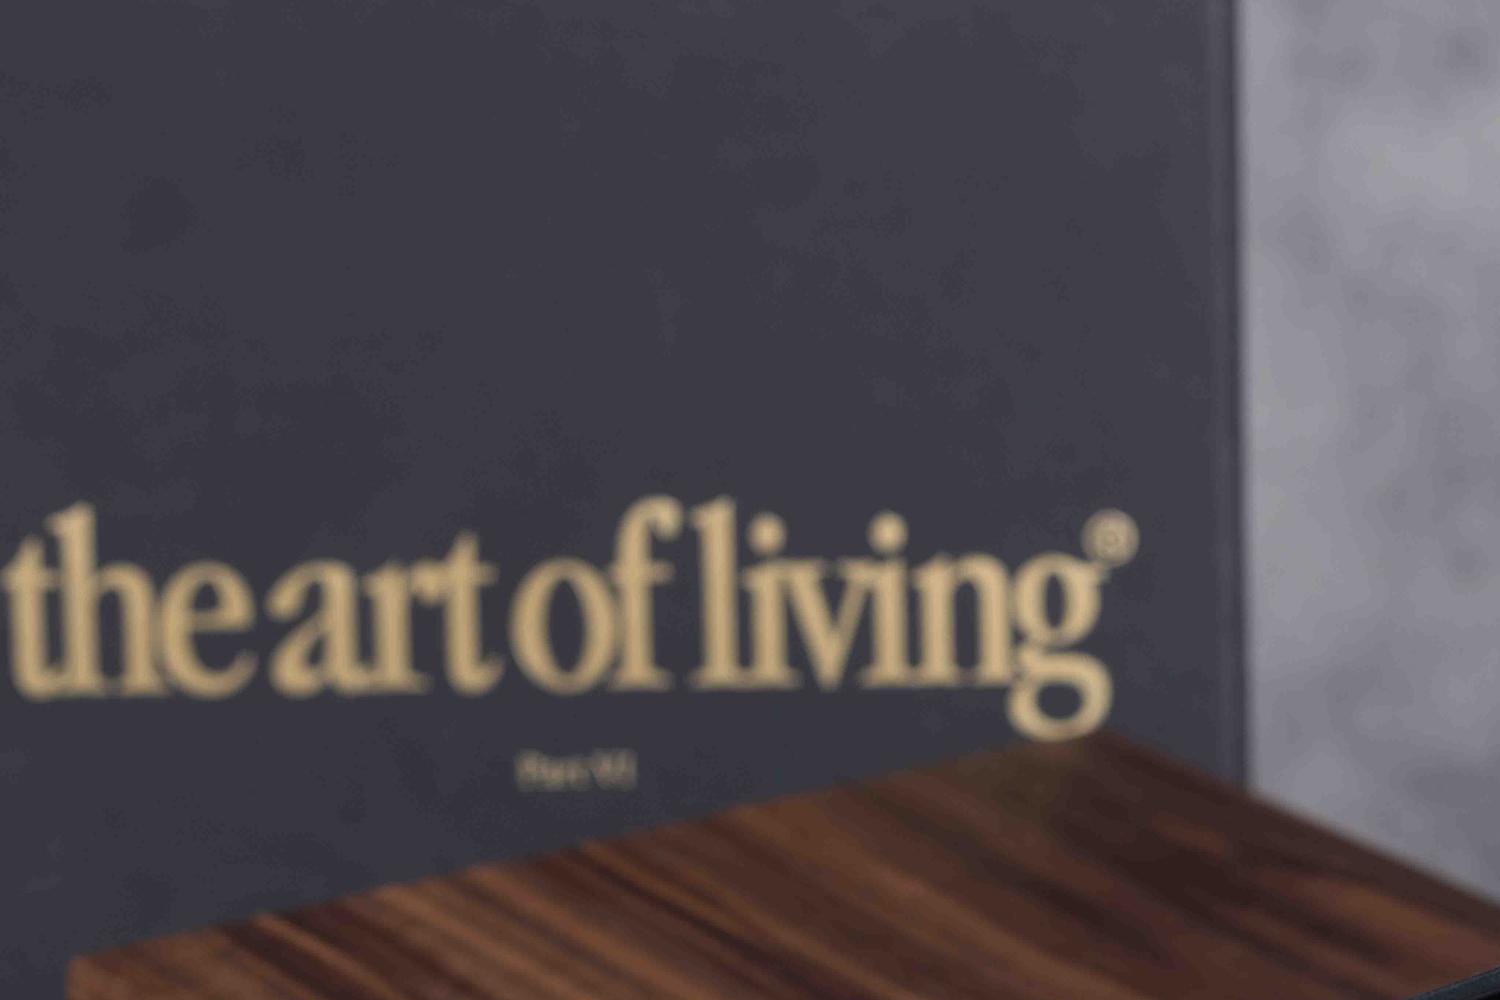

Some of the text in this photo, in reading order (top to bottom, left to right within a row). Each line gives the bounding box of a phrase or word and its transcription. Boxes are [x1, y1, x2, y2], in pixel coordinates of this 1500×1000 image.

[2, 502, 254, 700] the
[265, 529, 502, 697] art
[509, 496, 684, 697] of
